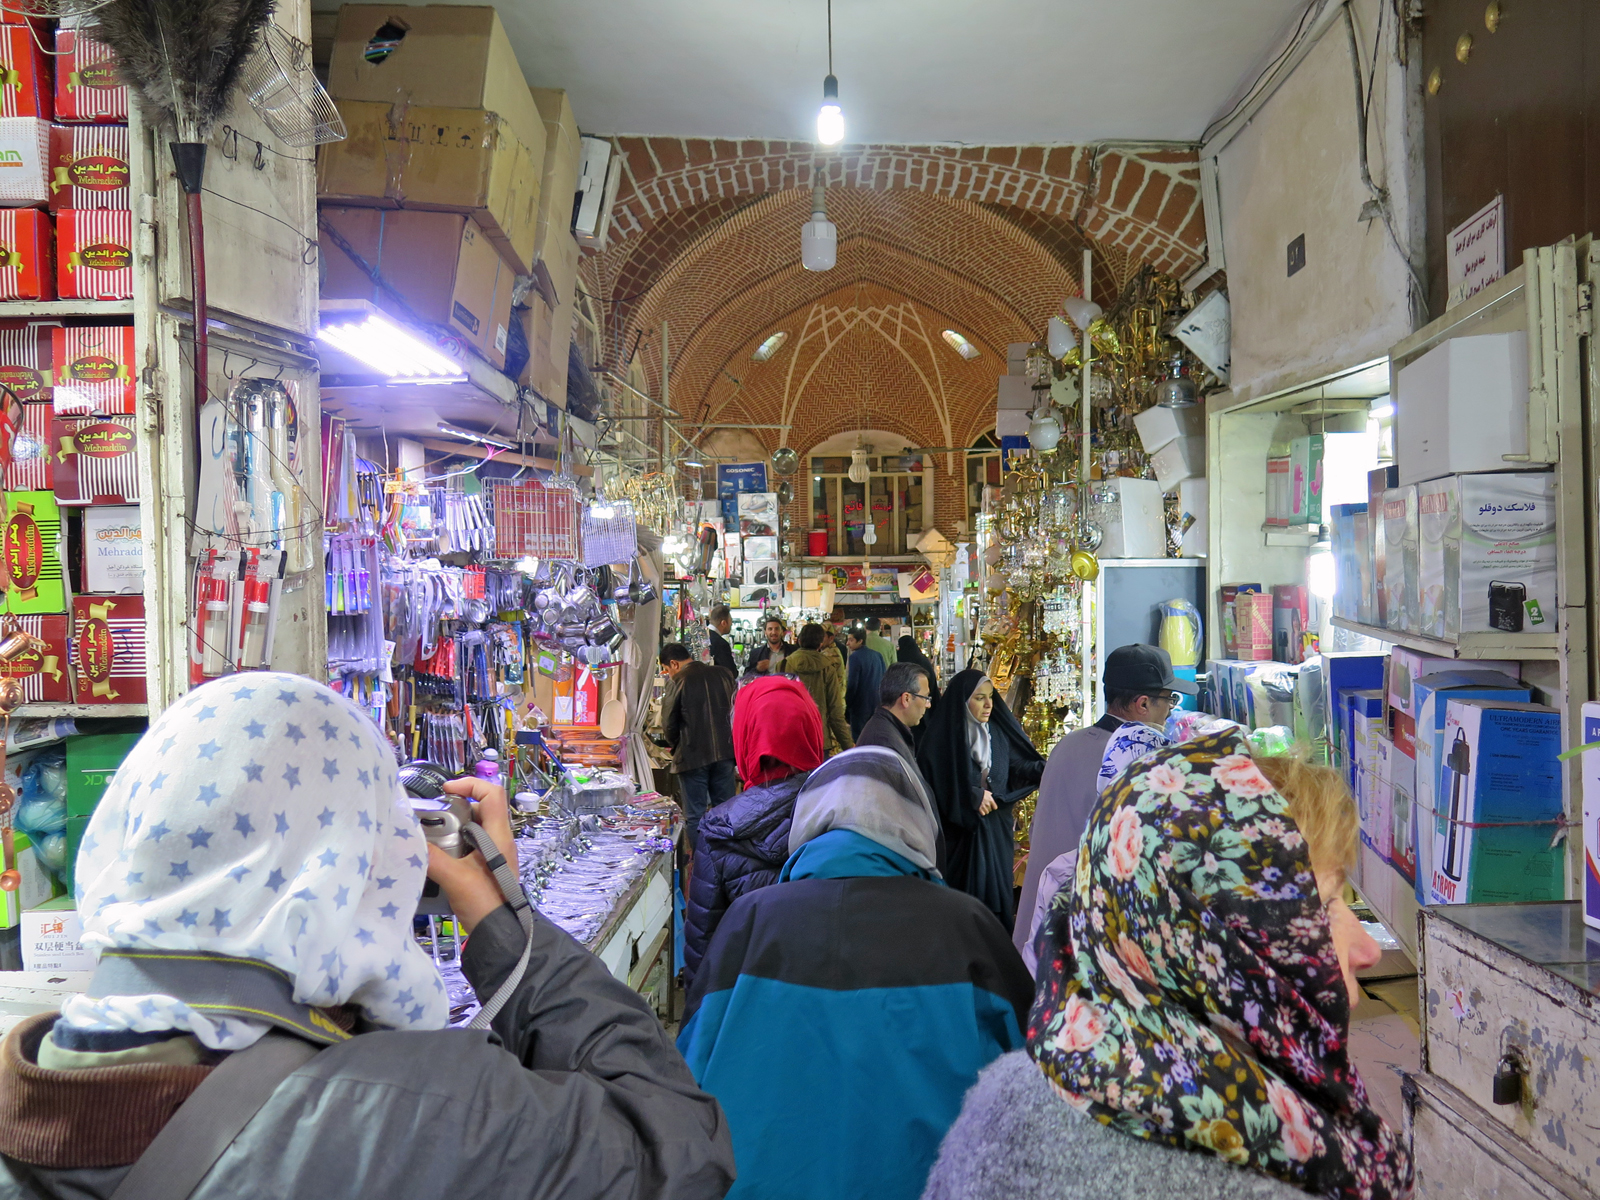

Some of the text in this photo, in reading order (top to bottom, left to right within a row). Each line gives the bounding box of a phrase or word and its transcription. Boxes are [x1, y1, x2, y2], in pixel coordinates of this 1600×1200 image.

[77, 175, 123, 185] Mehraddin
[84, 444, 127, 452] Mehraddin
[1478, 502, 1536, 515] فلاسک دوقلو
[26, 524, 36, 577] Mehraddin
[97, 547, 142, 557] Mehradd
[1530, 607, 1538, 616] 2
[99, 628, 108, 672] Mehraddin
[1489, 714, 1543, 725] ULTRAMODERN
[1432, 870, 1456, 902] AIRPOT
